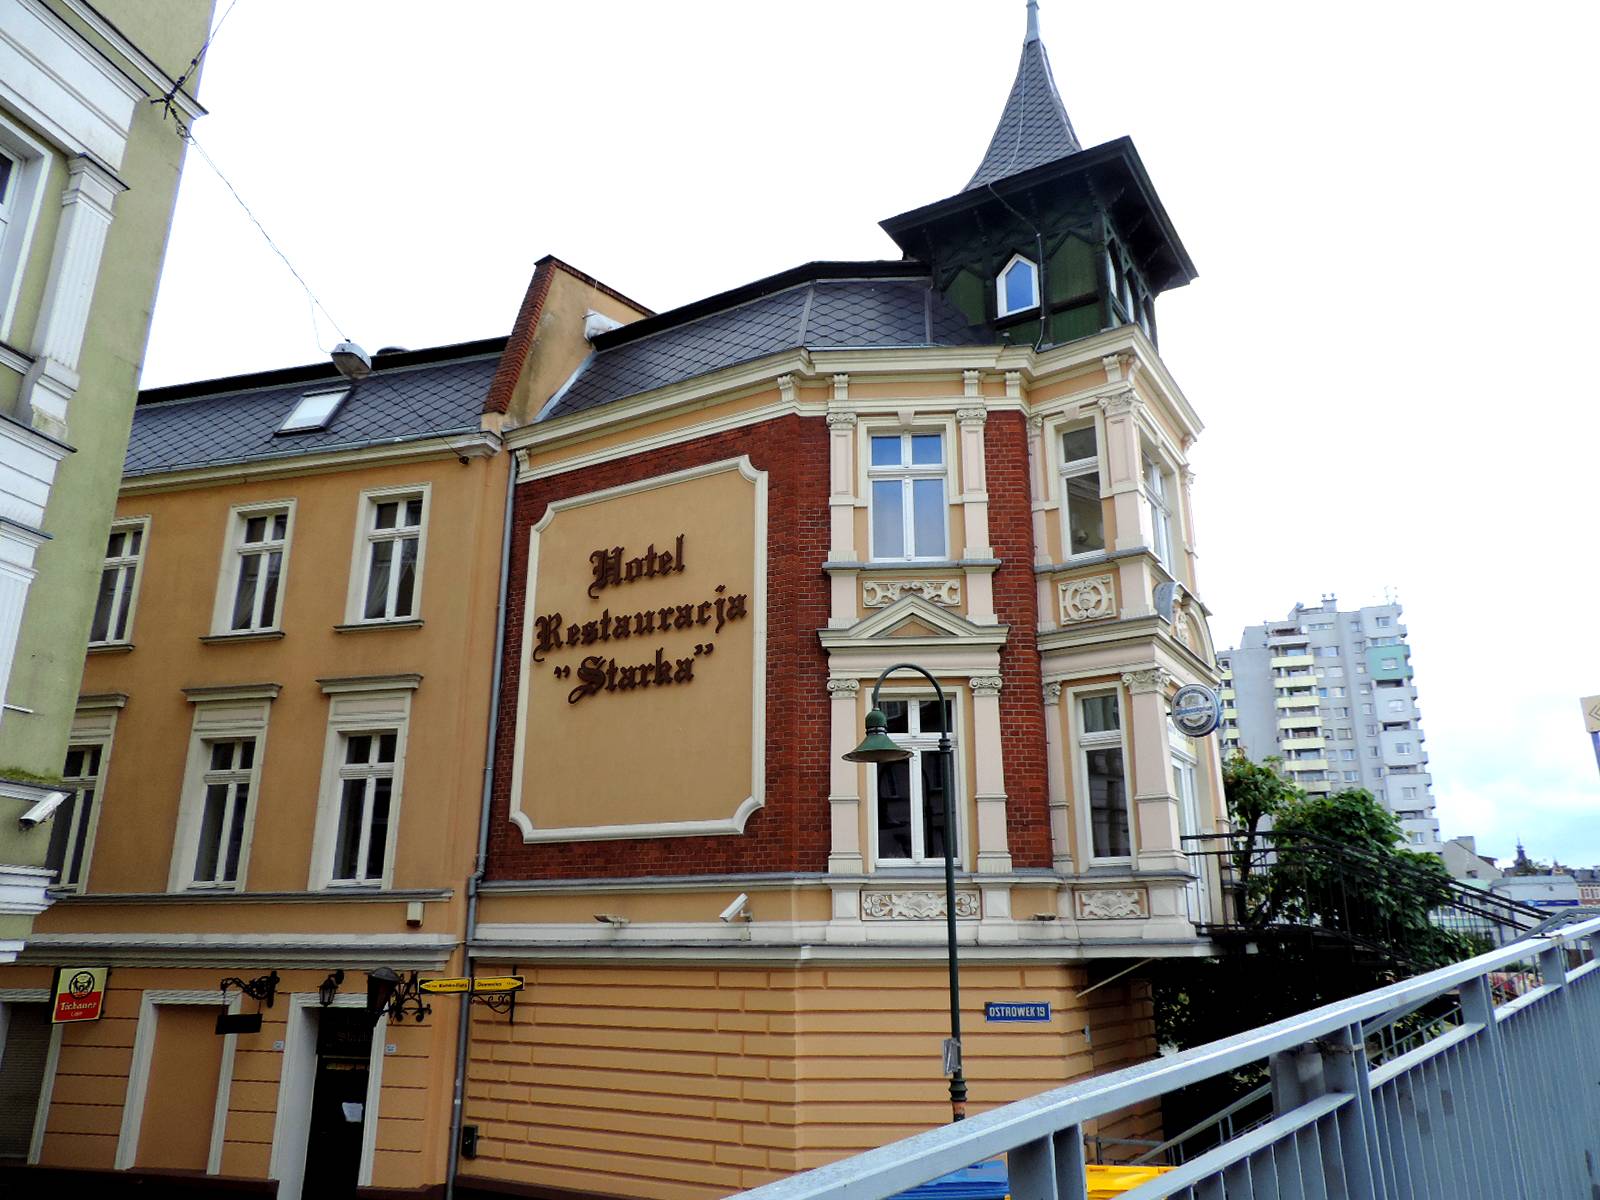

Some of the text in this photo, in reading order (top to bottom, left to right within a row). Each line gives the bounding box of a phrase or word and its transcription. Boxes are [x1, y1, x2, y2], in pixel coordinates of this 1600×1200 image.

[588, 533, 686, 600] Hotel
[532, 584, 748, 662] Restauracja
[1037, 1006, 1046, 1017] 19
